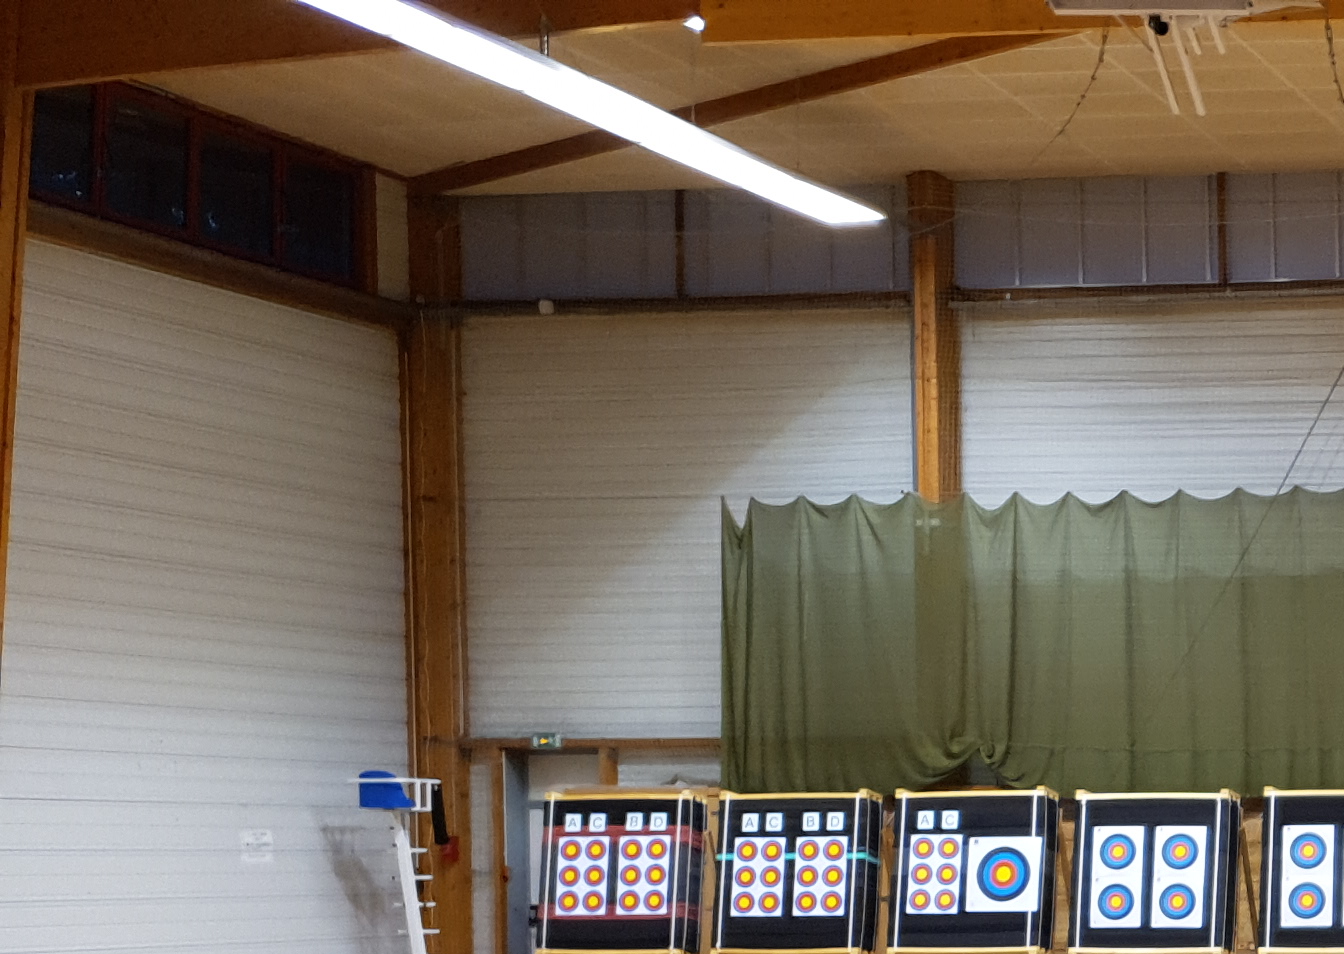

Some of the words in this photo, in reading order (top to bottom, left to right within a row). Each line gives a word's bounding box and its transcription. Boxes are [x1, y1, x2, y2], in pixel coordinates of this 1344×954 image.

[568, 817, 577, 828] A
[593, 816, 602, 829] C
[654, 816, 663, 828] D
[745, 817, 754, 828] A
[769, 816, 778, 828] C
[921, 815, 930, 826] A
[945, 814, 954, 826] C
